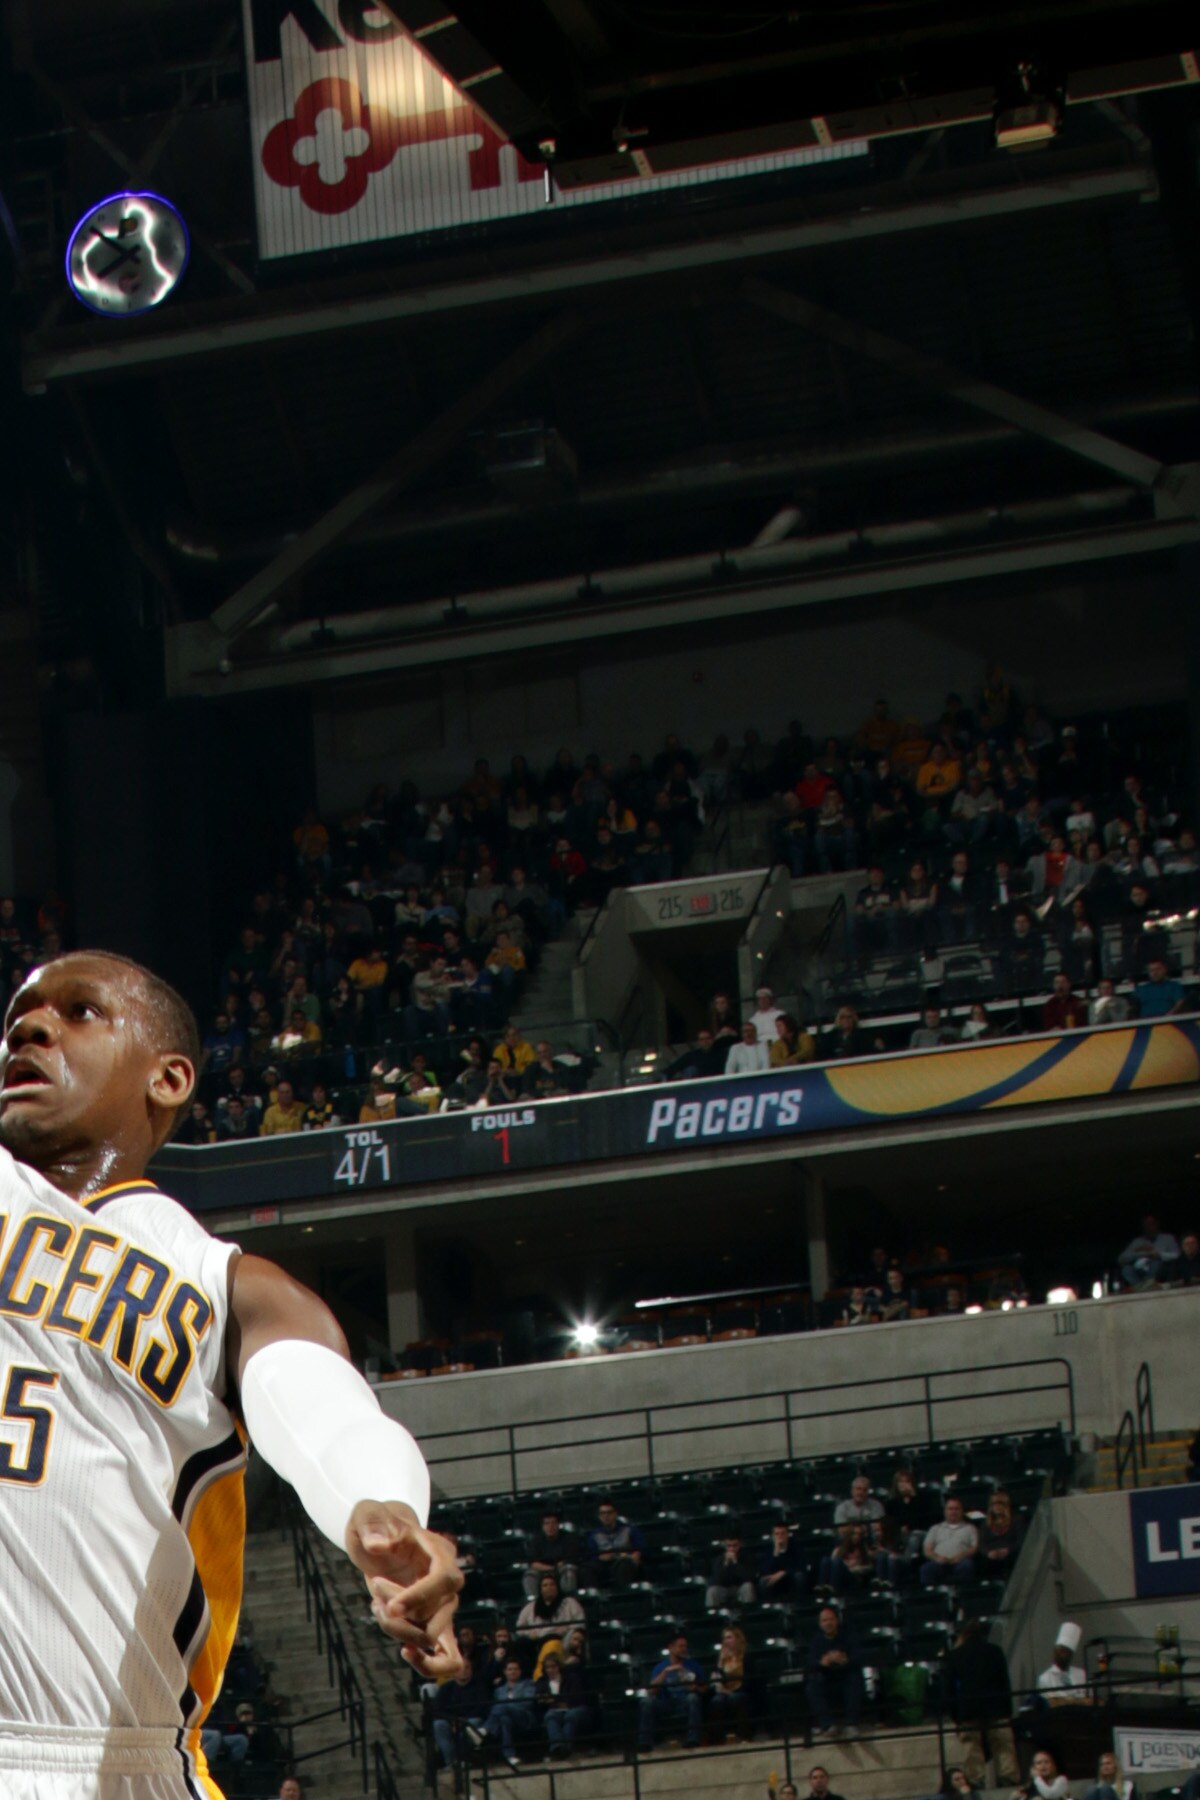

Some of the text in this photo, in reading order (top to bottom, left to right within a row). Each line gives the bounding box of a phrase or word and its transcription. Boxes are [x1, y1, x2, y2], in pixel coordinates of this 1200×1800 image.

[658, 895, 682, 919] 215
[720, 888, 743, 911] 216
[471, 1109, 536, 1131] FOULS
[646, 1088, 803, 1144] Pacers
[345, 1130, 383, 1147] TOL
[493, 1128, 510, 1164] 1
[334, 1144, 390, 1185] 4/1
[1053, 1311, 1078, 1336] 110
[1127, 1741, 1200, 1767] LEGEND
